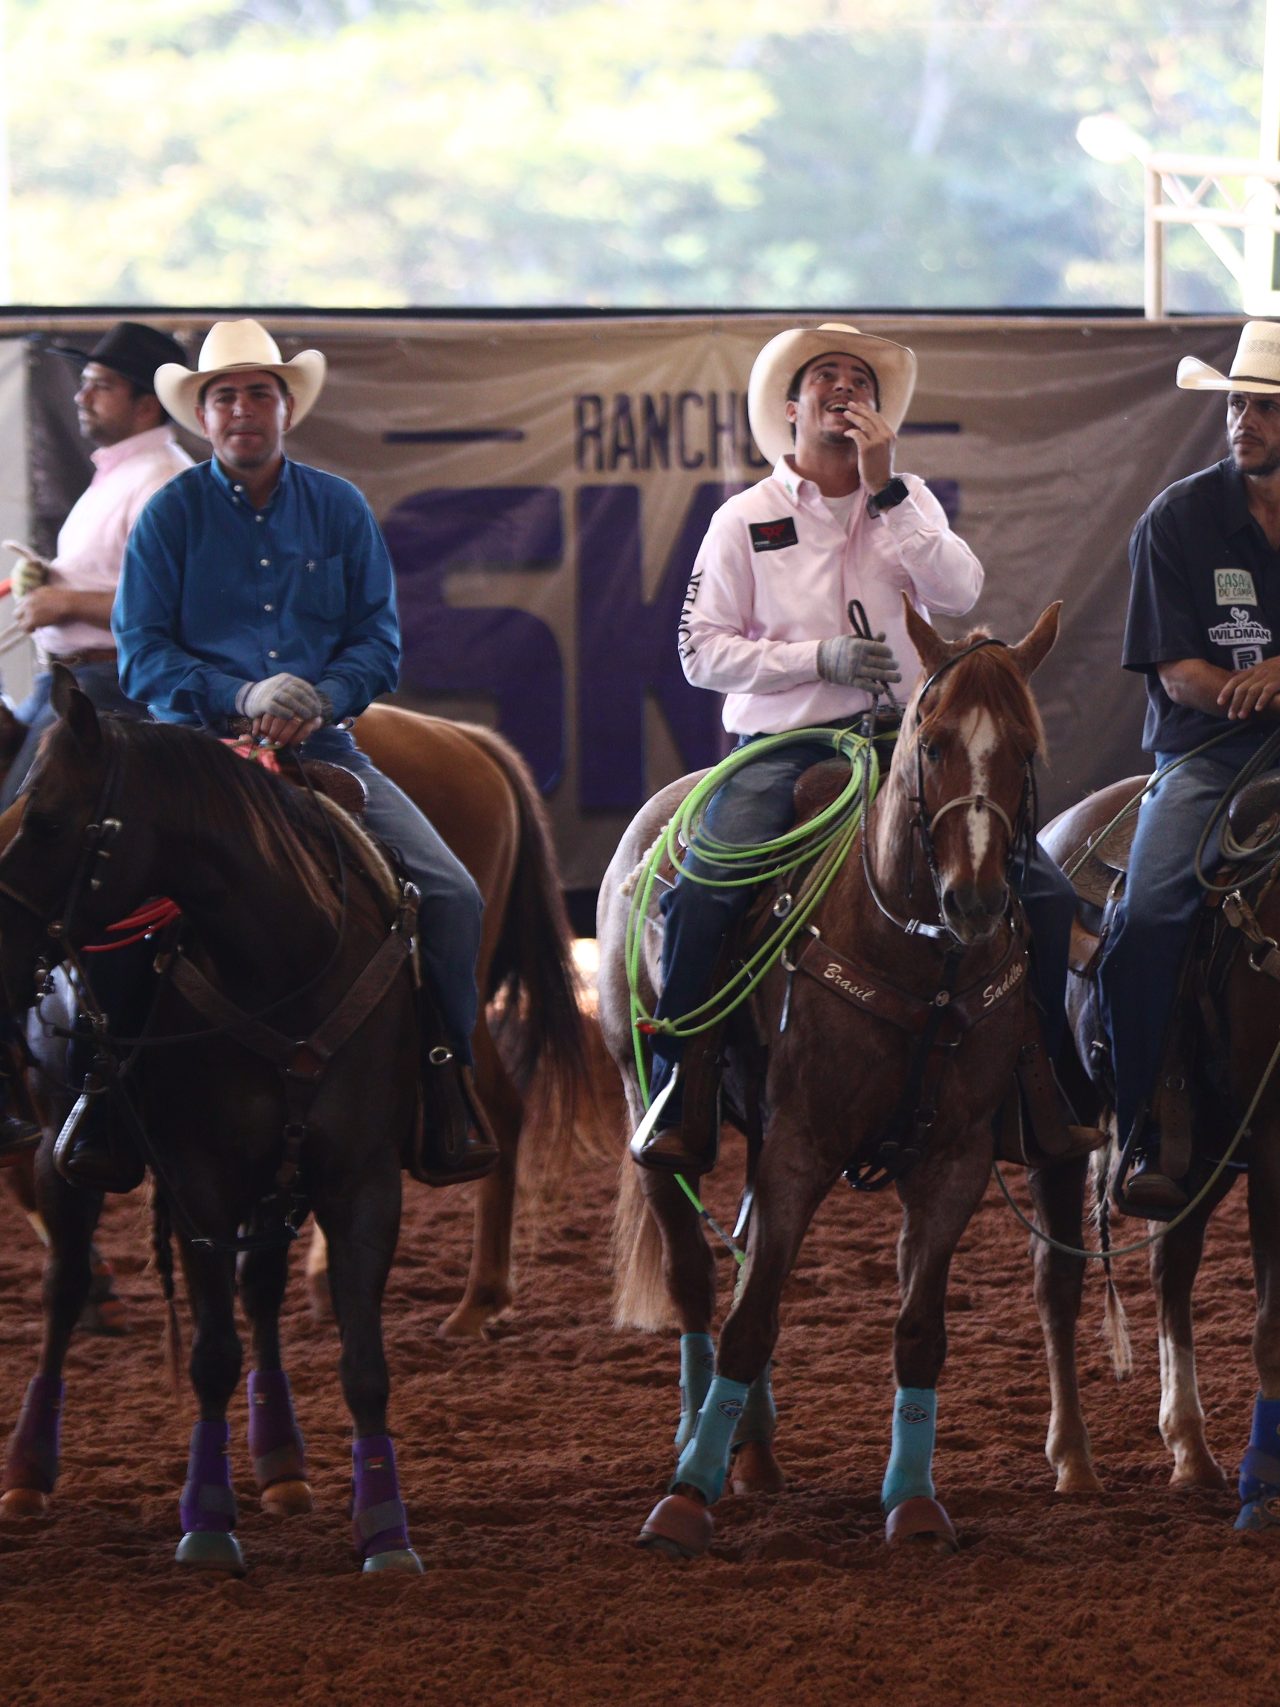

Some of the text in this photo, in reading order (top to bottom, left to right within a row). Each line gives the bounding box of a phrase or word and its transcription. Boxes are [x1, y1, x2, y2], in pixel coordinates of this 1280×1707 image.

[1217, 572, 1245, 588] CASA
[1210, 628, 1270, 641] WILDMAN
[823, 963, 876, 1002] Brasil
